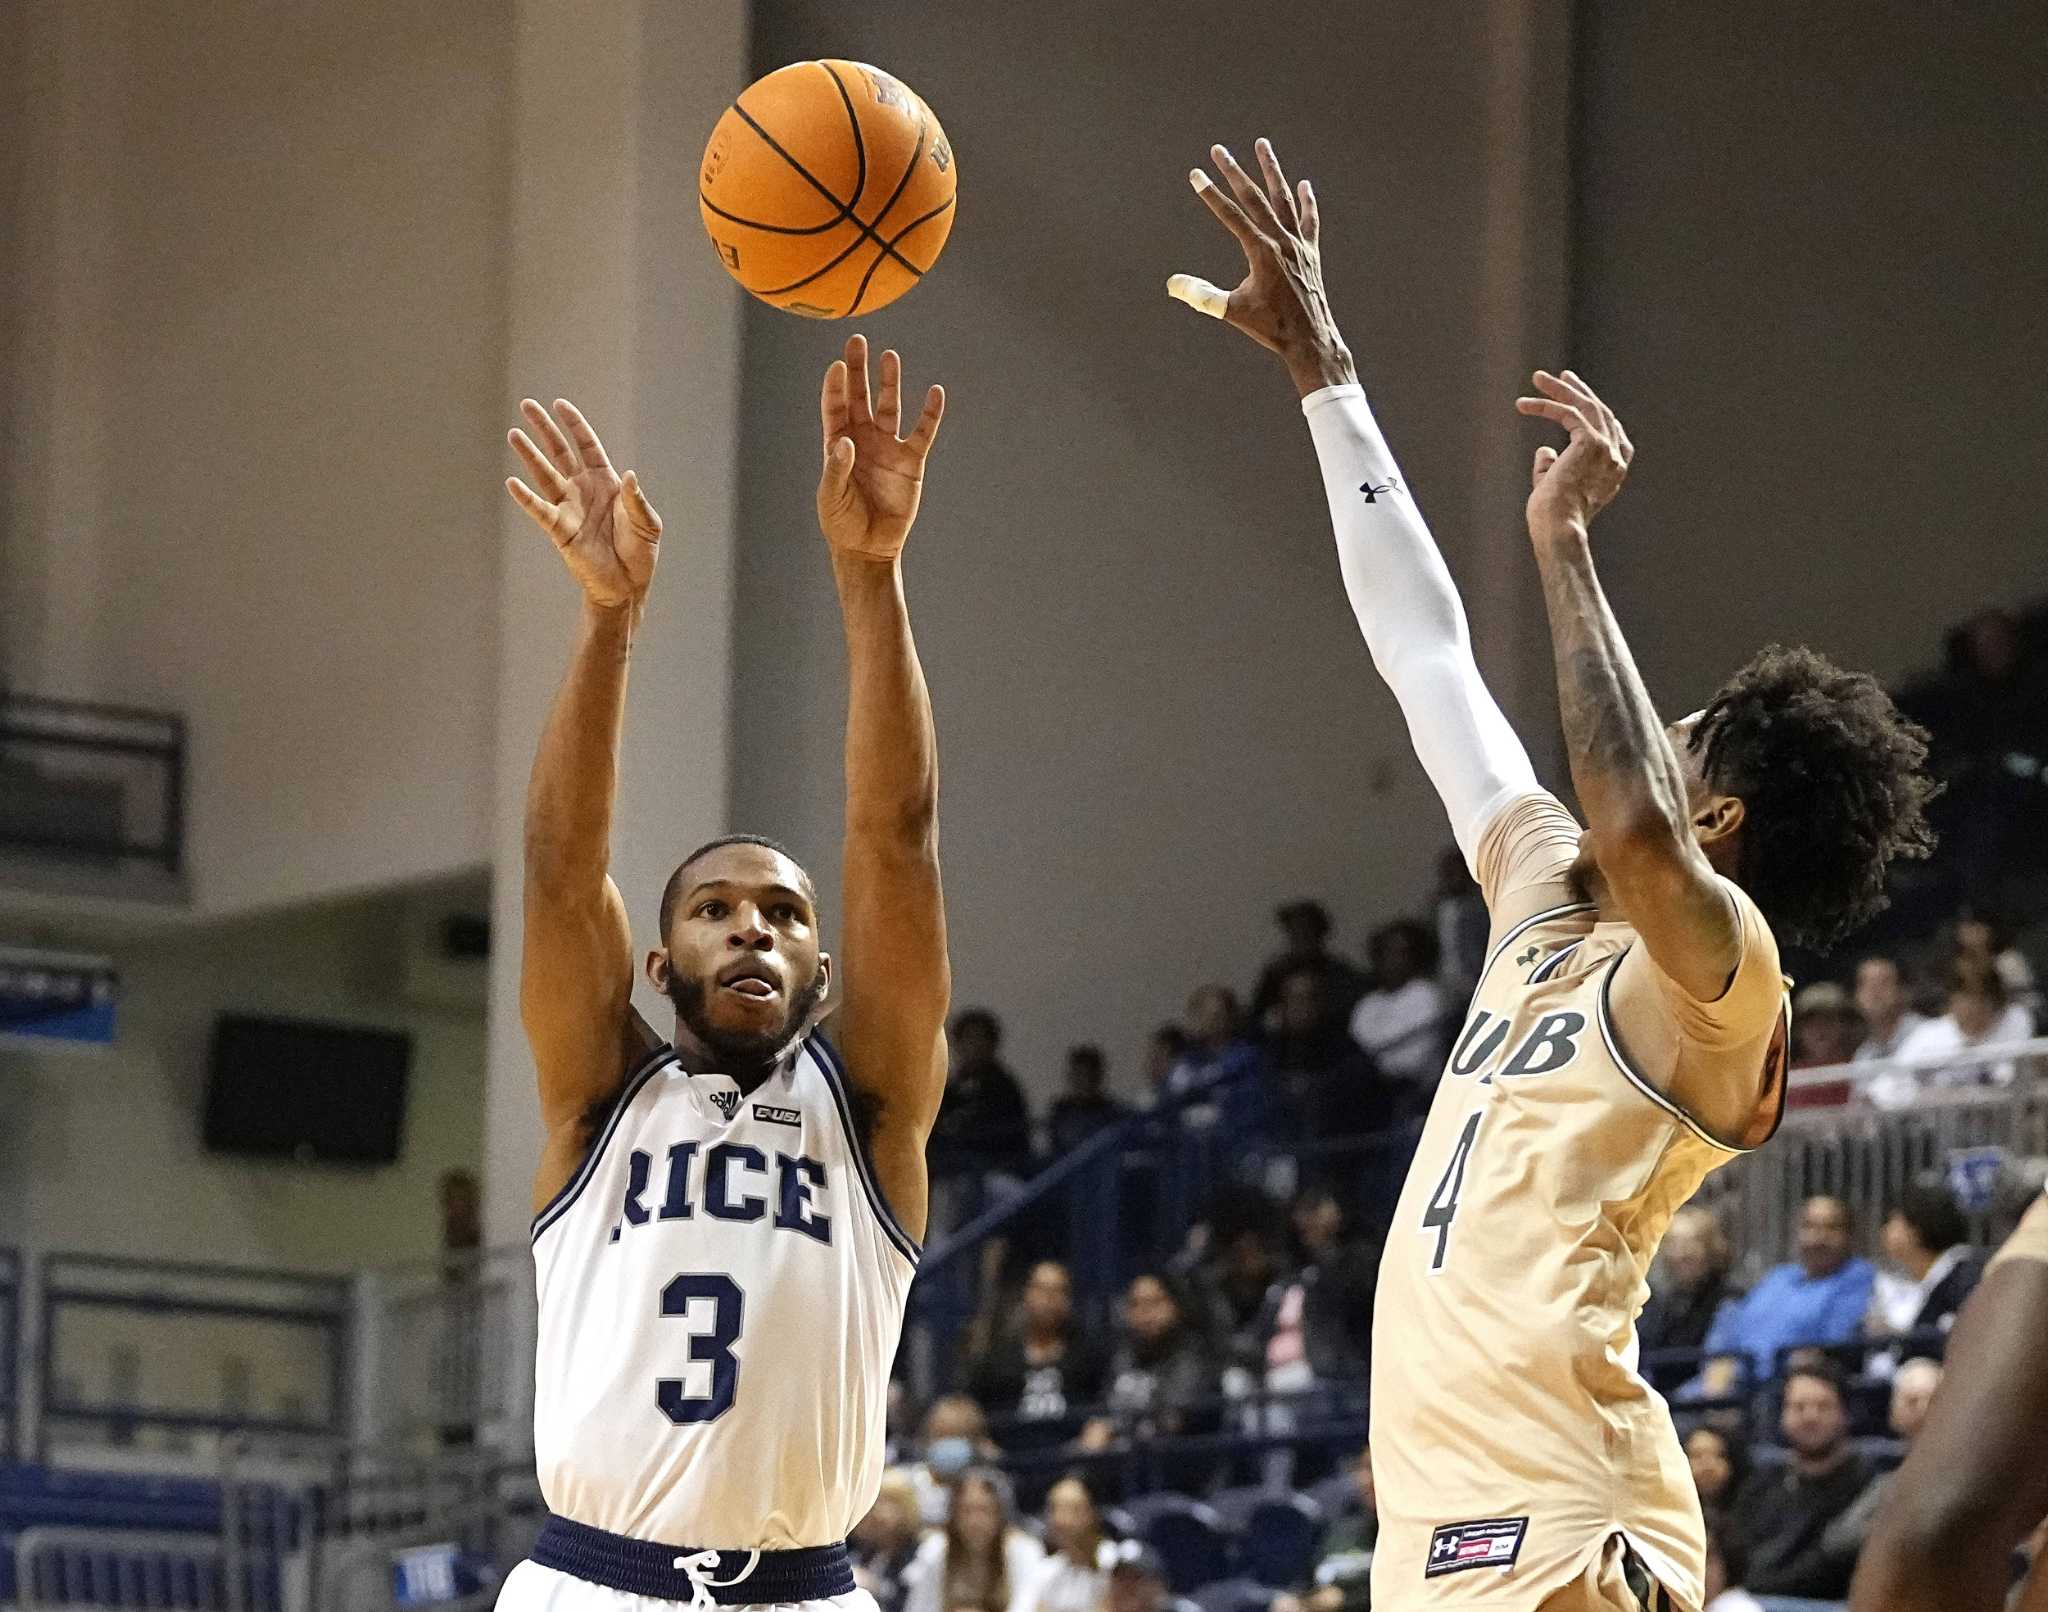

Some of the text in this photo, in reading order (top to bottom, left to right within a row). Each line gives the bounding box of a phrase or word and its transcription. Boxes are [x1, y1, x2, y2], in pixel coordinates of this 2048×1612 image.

[1450, 1010, 1588, 1085] UB
[1421, 1110, 1484, 1271] 4
[655, 1272, 746, 1426] 3
